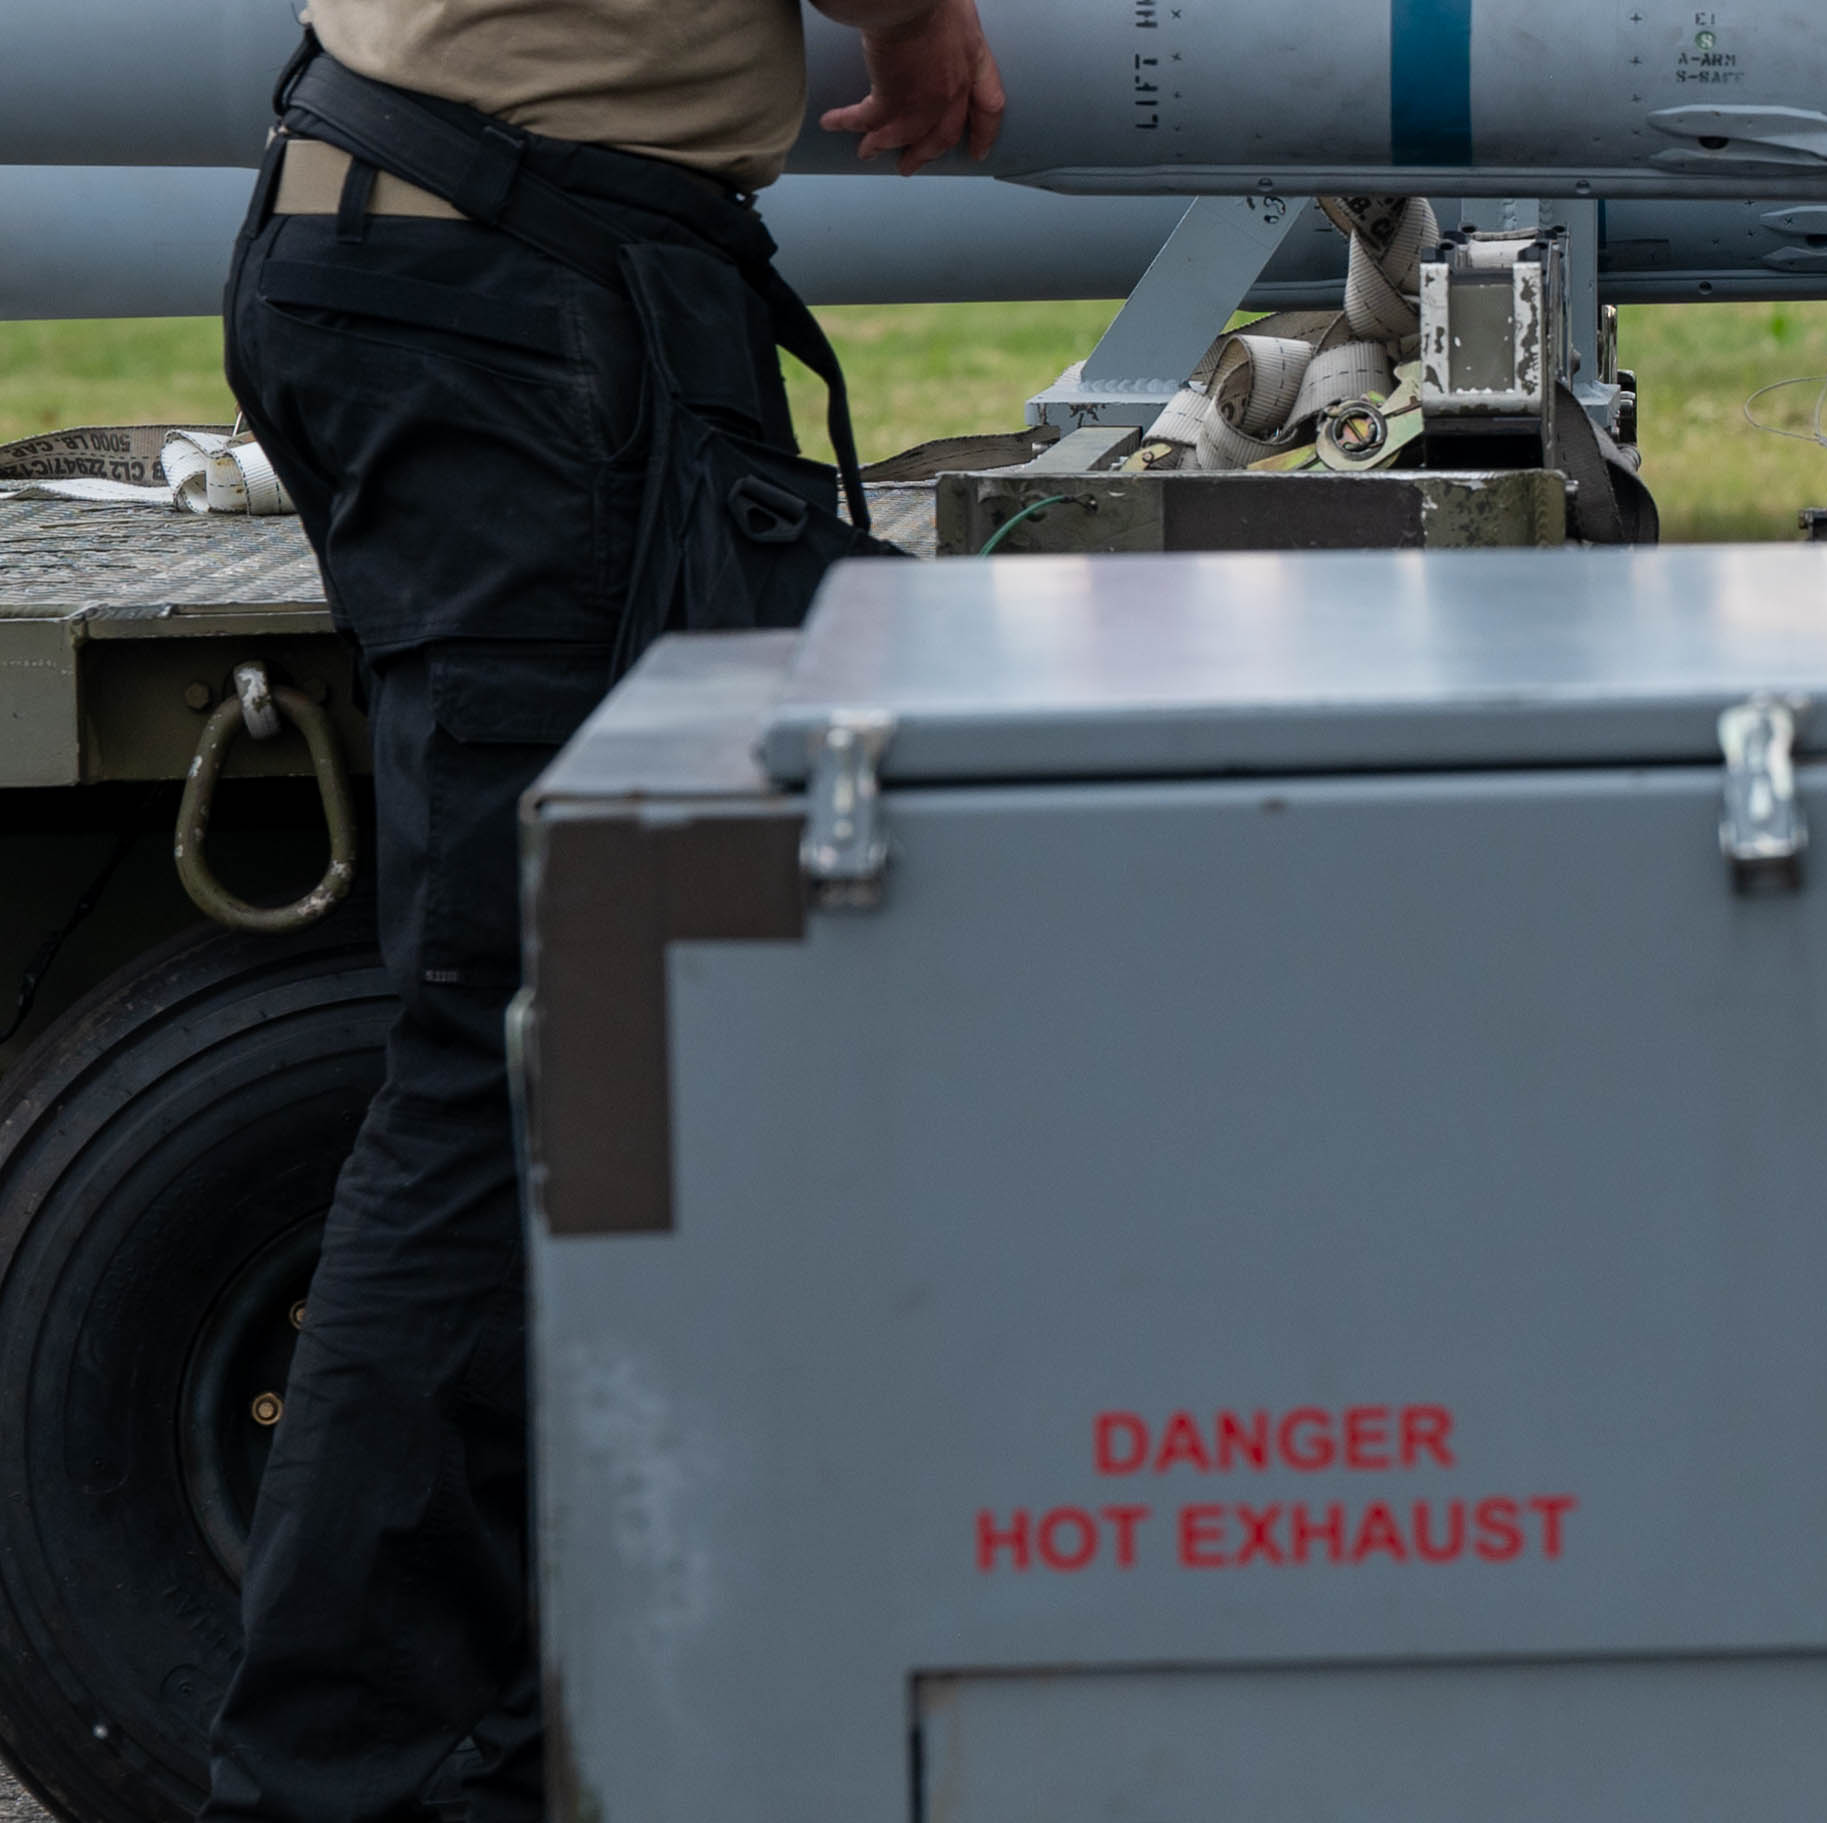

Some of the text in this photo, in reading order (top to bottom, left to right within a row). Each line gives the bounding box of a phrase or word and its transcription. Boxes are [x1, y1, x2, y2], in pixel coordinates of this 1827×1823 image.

[1134, 53, 1159, 128] LIFT
[91, 433, 131, 454] 5000
[110, 460, 146, 481] CL2
[1093, 1403, 1456, 1476] DANGER
[976, 1493, 1580, 1573] HOT EXHAUST
